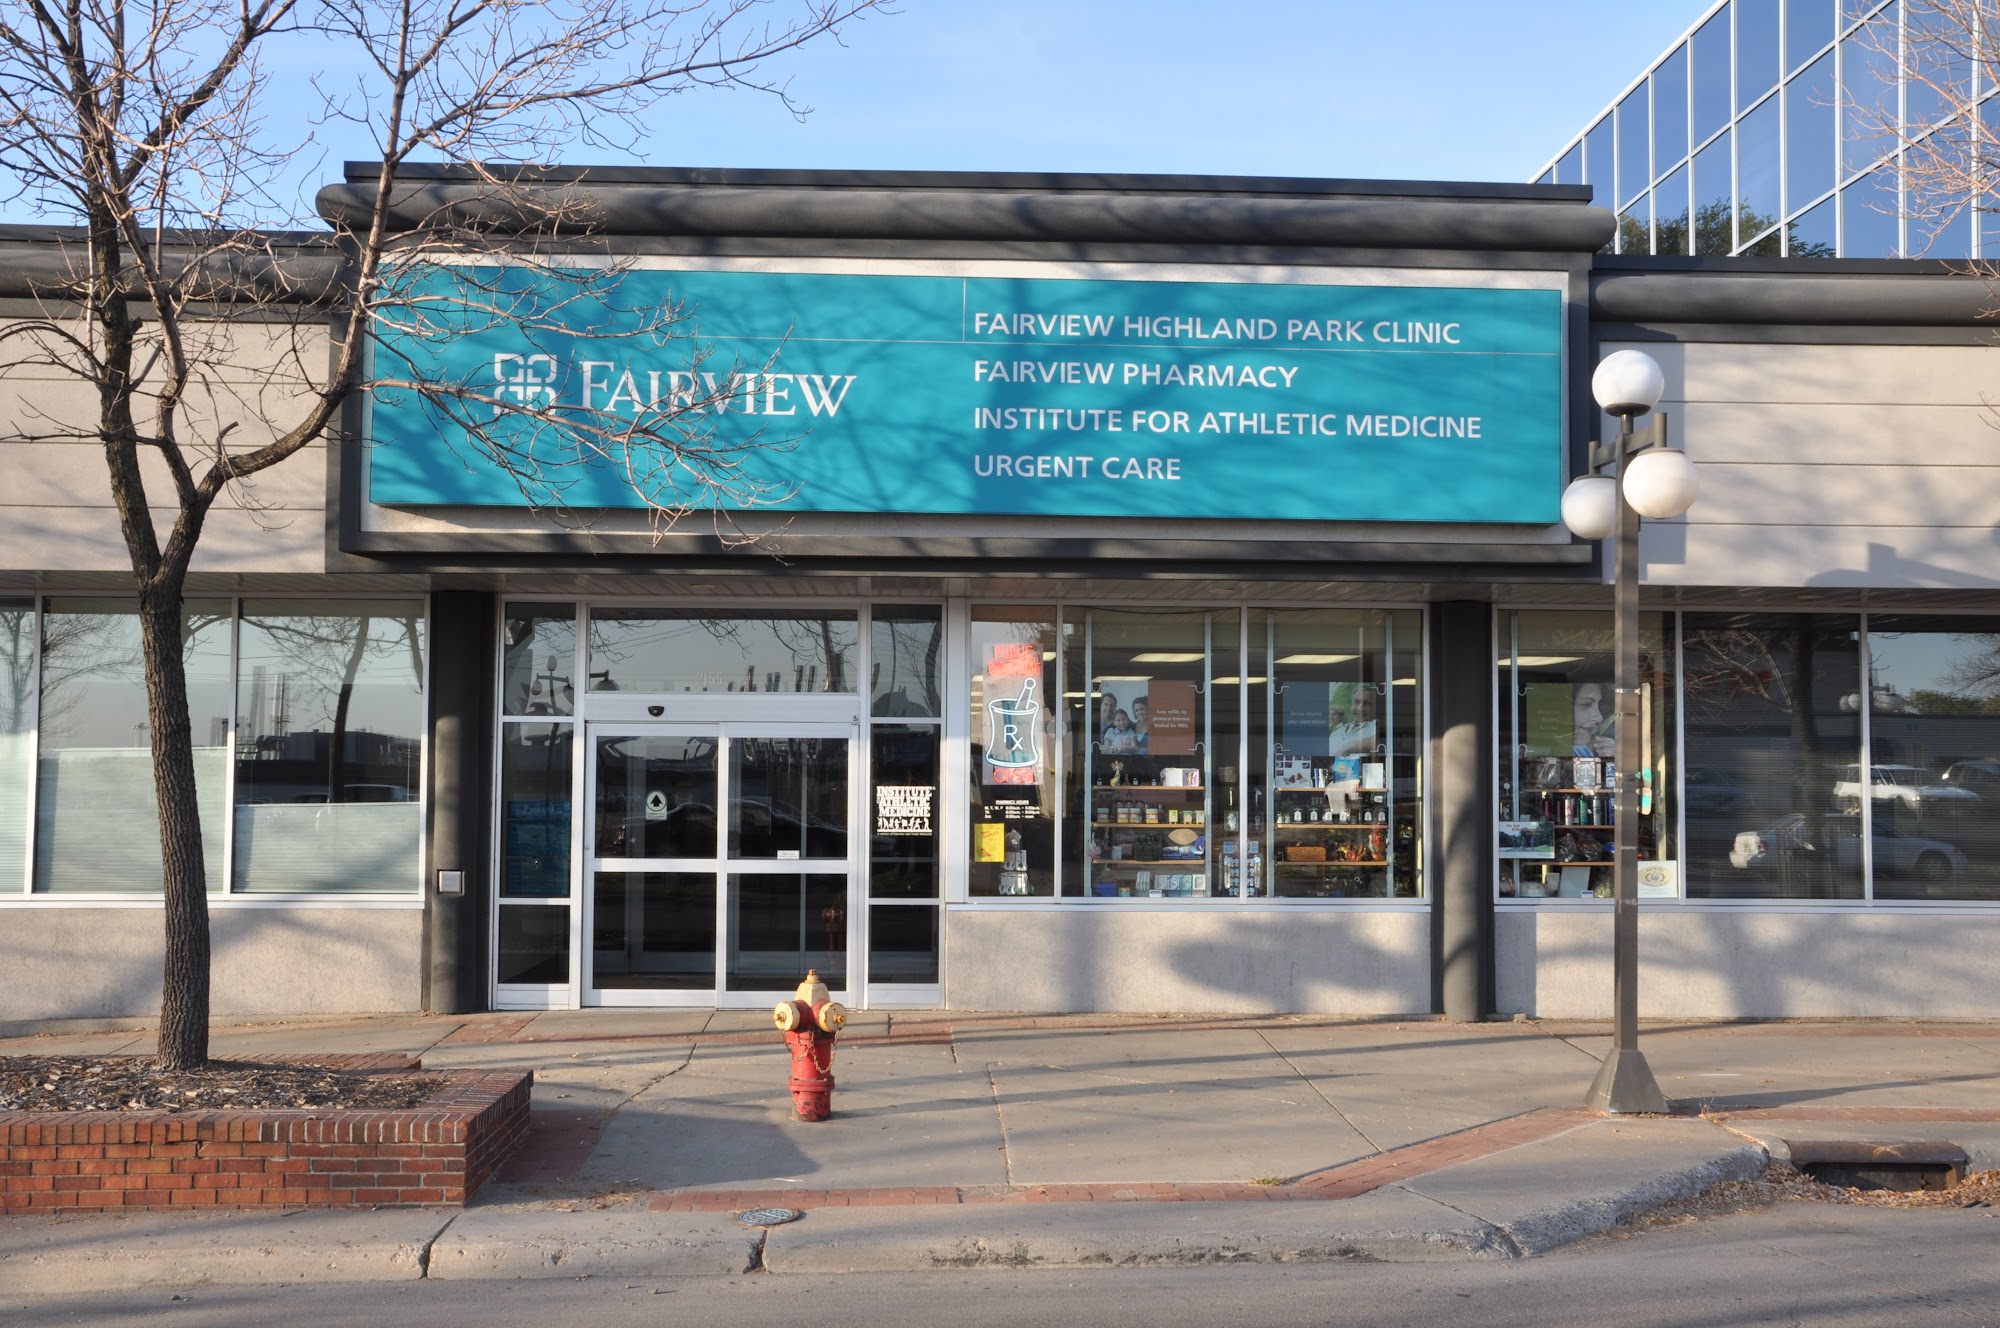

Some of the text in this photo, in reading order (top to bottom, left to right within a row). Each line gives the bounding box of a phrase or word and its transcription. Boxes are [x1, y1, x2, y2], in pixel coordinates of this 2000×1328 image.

[974, 312, 1461, 344] FAIRVIEW HIGHLAND PARK CLINIC
[974, 360, 1299, 388] FAIRVIEW PHARMACY
[580, 360, 857, 418] FAIRVIEW
[974, 407, 1482, 439] INSTITUTE FOR ATHLETIC MEDICINE
[974, 455, 1181, 481] URGENT CARE
[697, 671, 723, 687] 2155
[1004, 724, 1024, 751] Rx
[993, 768, 1035, 784] OPEN
[877, 786, 932, 797] INSTITUTE
[879, 796, 930, 806] ATHLETIC
[879, 806, 930, 817] MEDICINE
